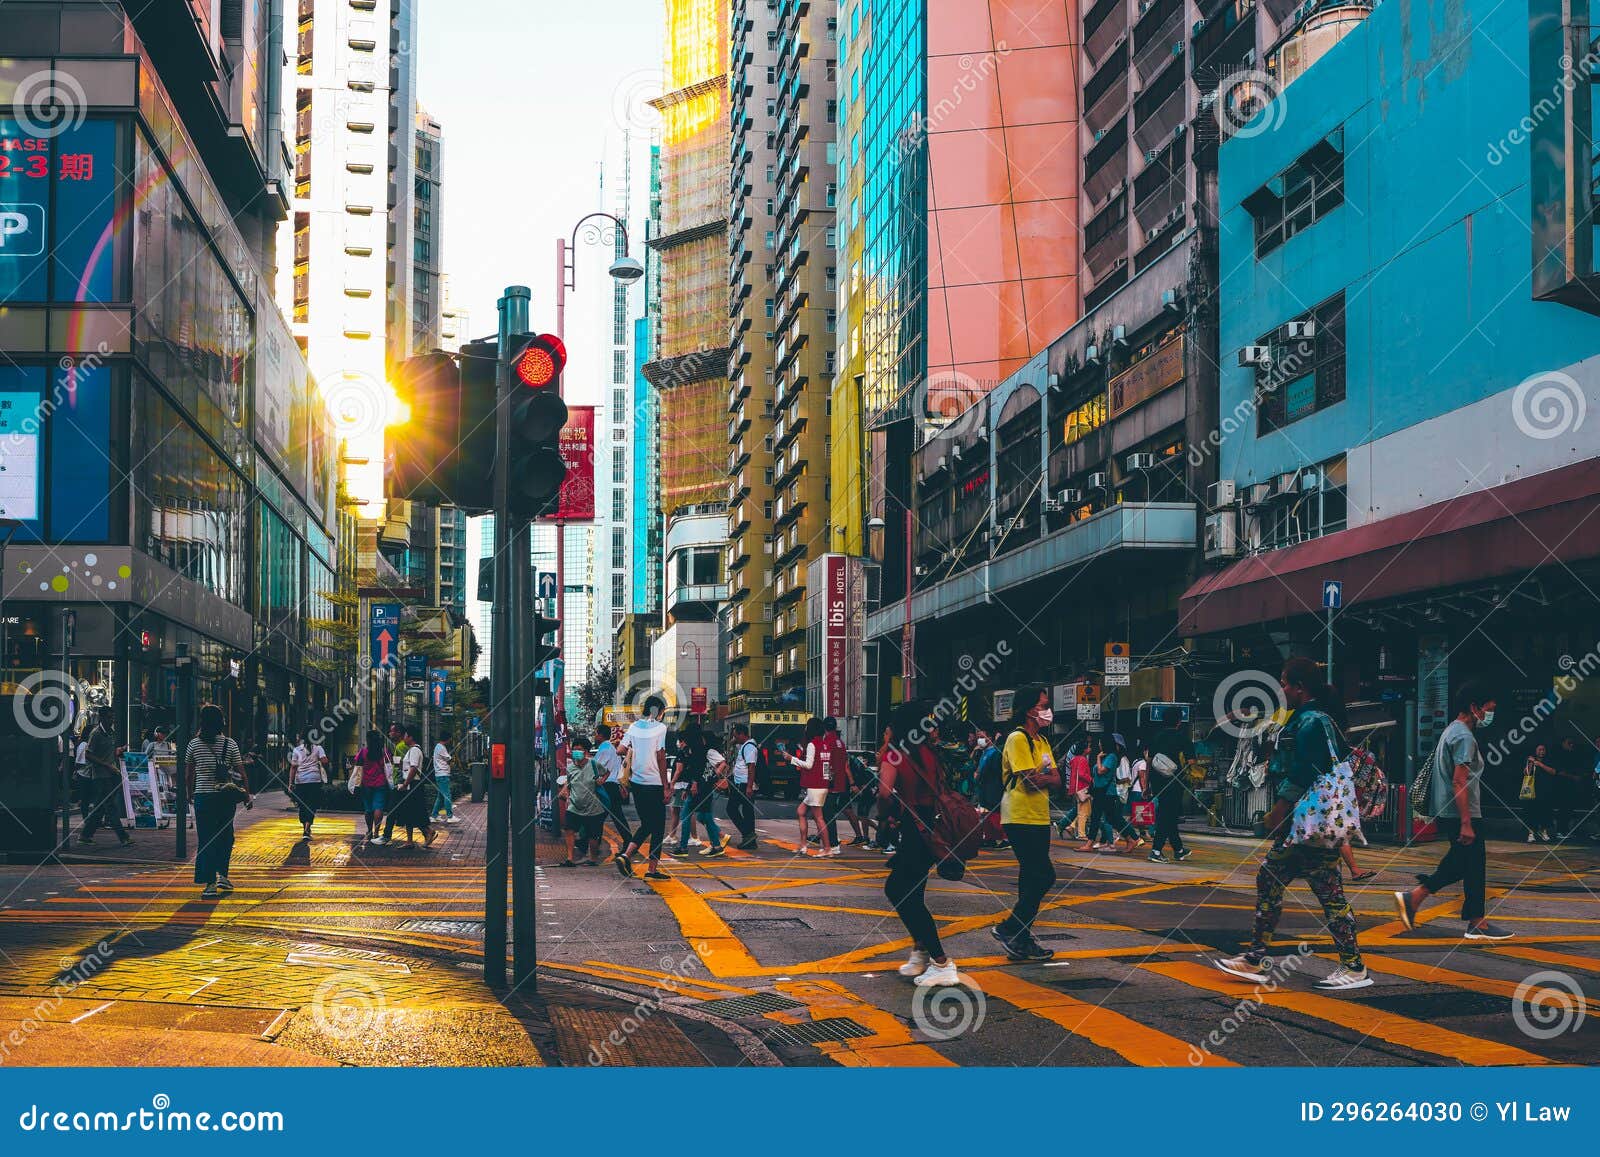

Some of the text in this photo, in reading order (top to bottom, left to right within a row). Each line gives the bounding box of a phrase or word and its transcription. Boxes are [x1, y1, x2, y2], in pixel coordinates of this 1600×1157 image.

[59, 153, 94, 181] 期
[0, 212, 29, 248] P
[829, 566, 845, 627] ibis HOTEL
[376, 608, 384, 618] P
